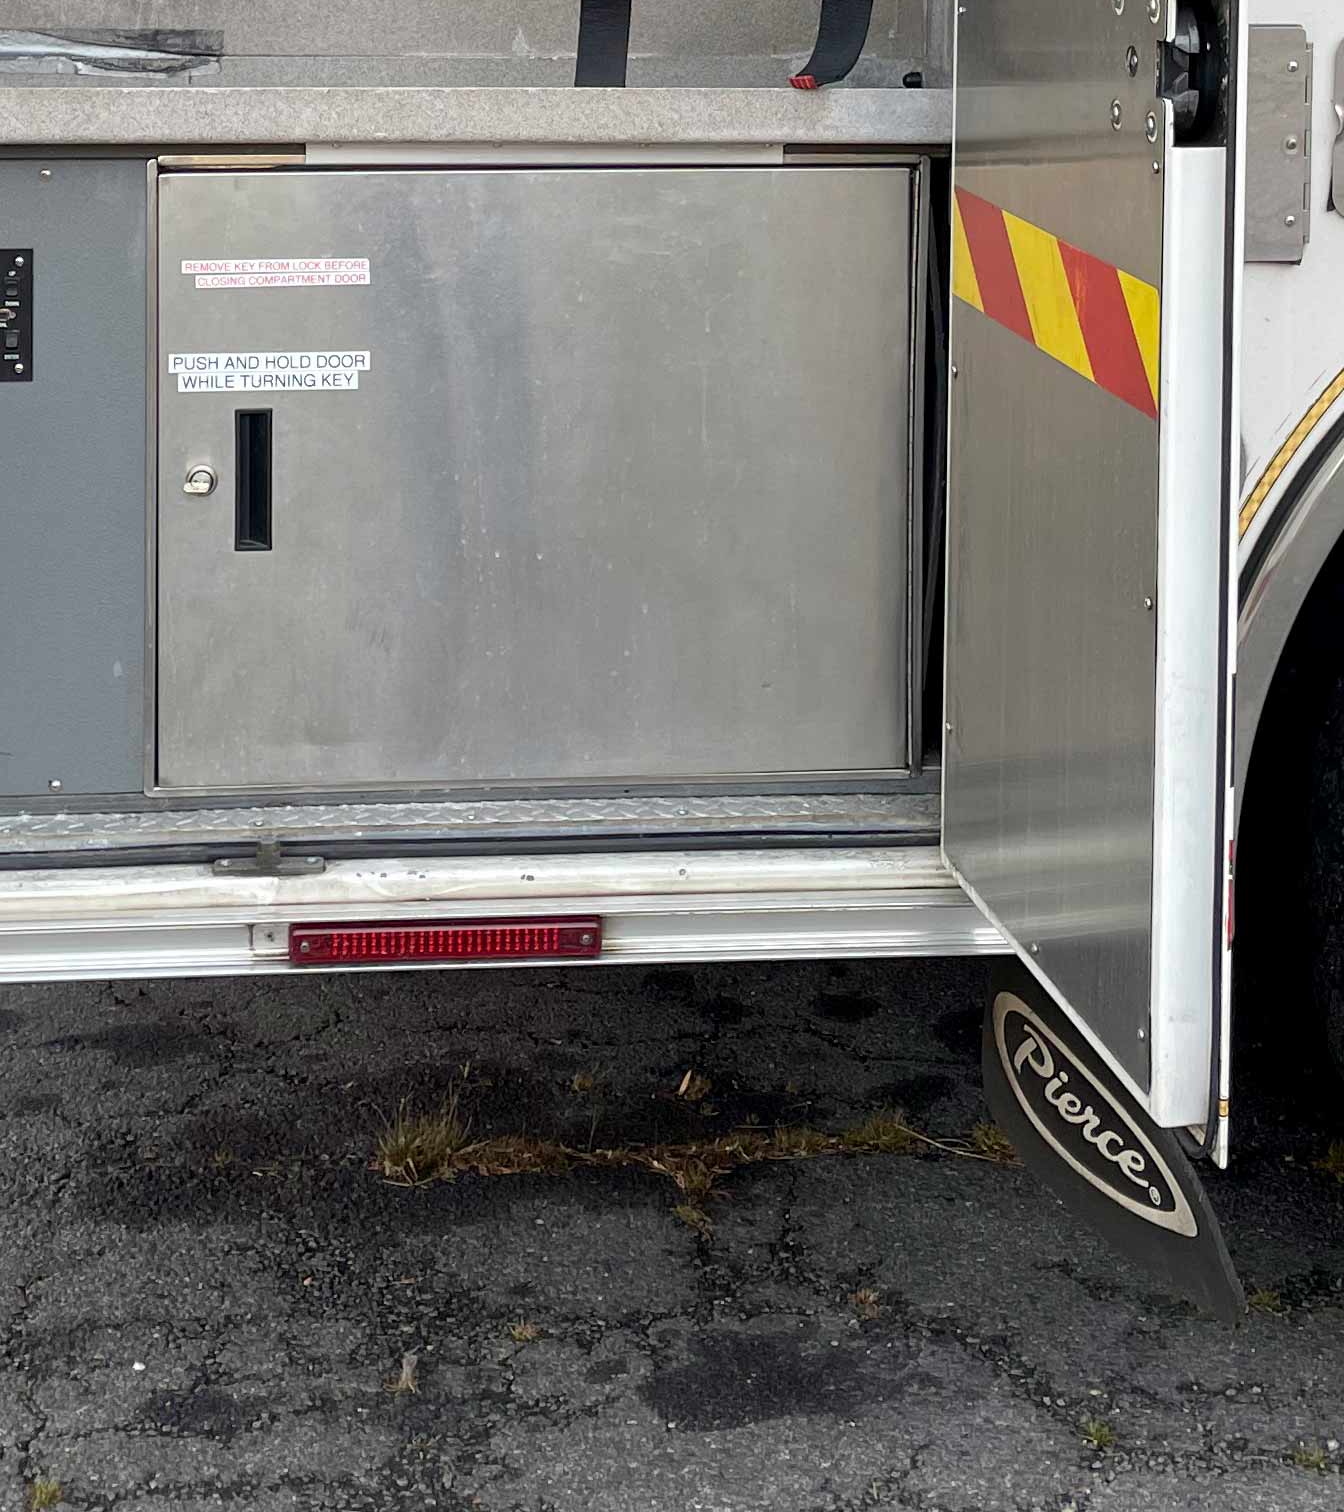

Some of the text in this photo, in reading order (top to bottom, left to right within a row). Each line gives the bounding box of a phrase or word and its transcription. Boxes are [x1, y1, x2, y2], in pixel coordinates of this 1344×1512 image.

[184, 260, 367, 272] REMOVE KEY FROM LOCK BEFORE
[197, 273, 366, 287] CLOSING COMPARTMENT DOOR
[173, 354, 366, 370] PUSH AND HOLD DOOR
[182, 373, 354, 389] WHILE TURNING KEY
[1013, 1024, 1150, 1188] Pierce
